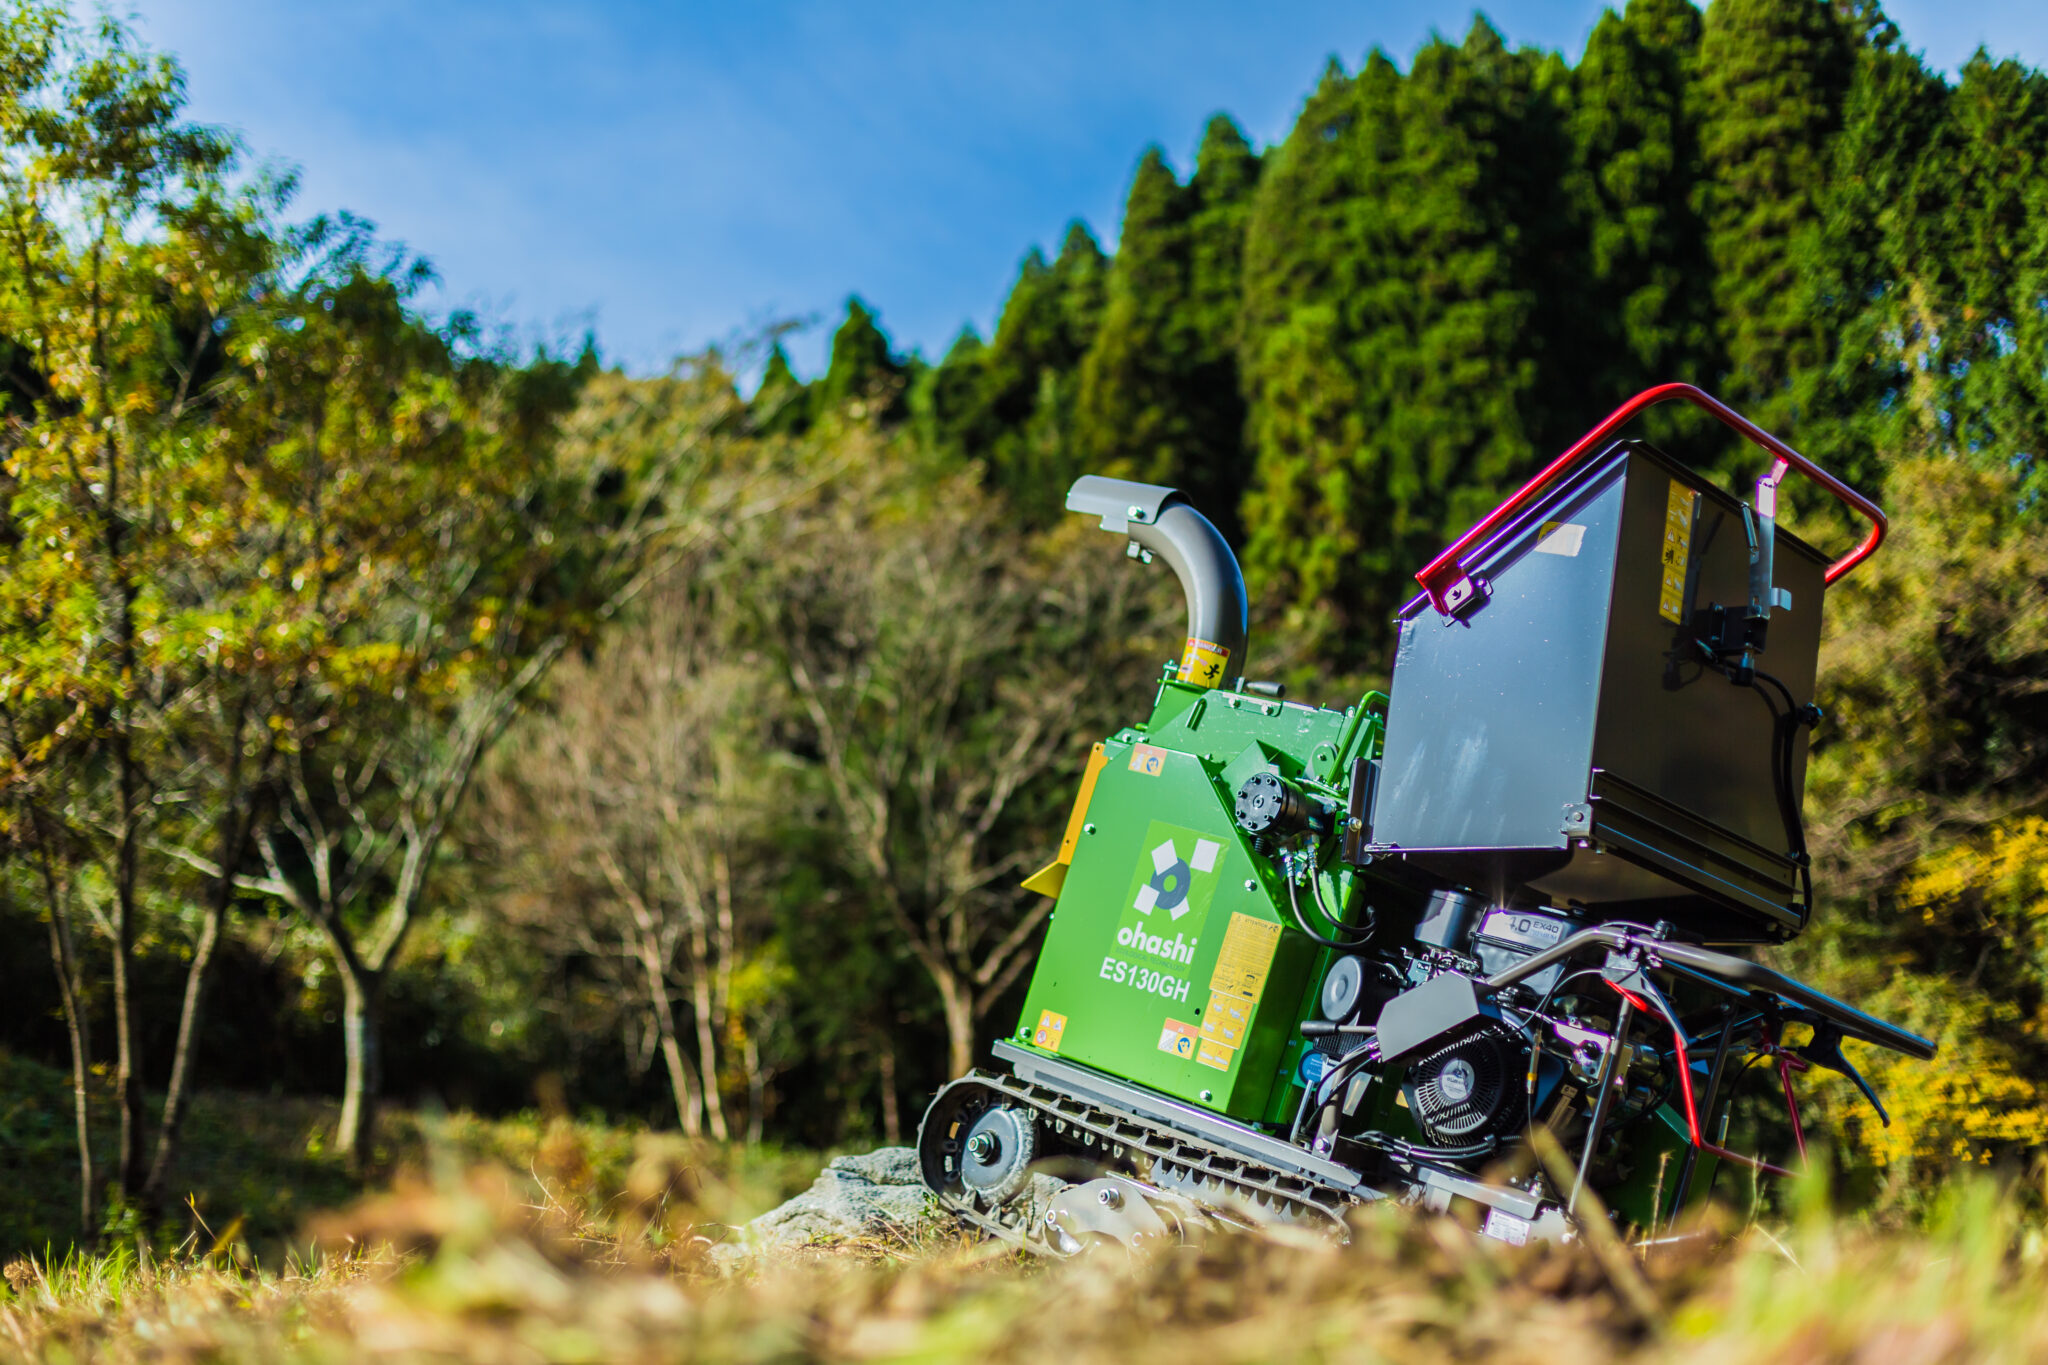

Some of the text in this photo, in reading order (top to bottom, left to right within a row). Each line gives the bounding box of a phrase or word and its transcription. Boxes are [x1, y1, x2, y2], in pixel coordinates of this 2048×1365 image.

[1117, 920, 1198, 965] ohashi
[1533, 921, 1559, 934] EX40
[1099, 956, 1191, 1003] ES130GH
